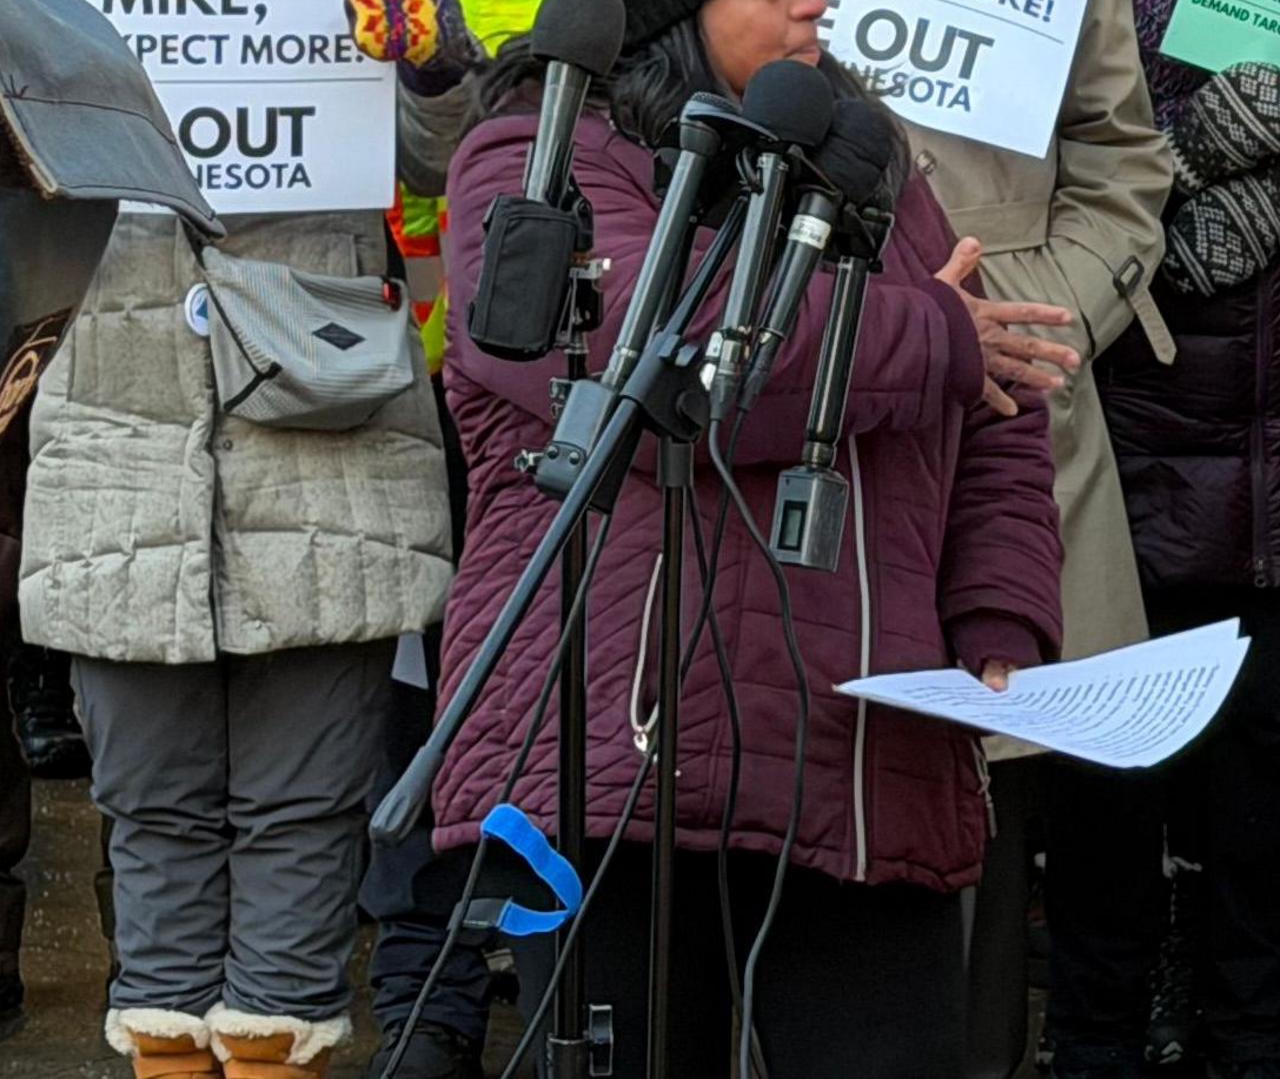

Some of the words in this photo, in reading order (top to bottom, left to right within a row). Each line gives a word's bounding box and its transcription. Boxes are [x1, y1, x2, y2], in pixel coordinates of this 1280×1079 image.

[241, 34, 365, 64] MORE
[855, 8, 995, 81] OUT
[179, 107, 316, 159] OUT
[195, 163, 312, 190] ESOTA
